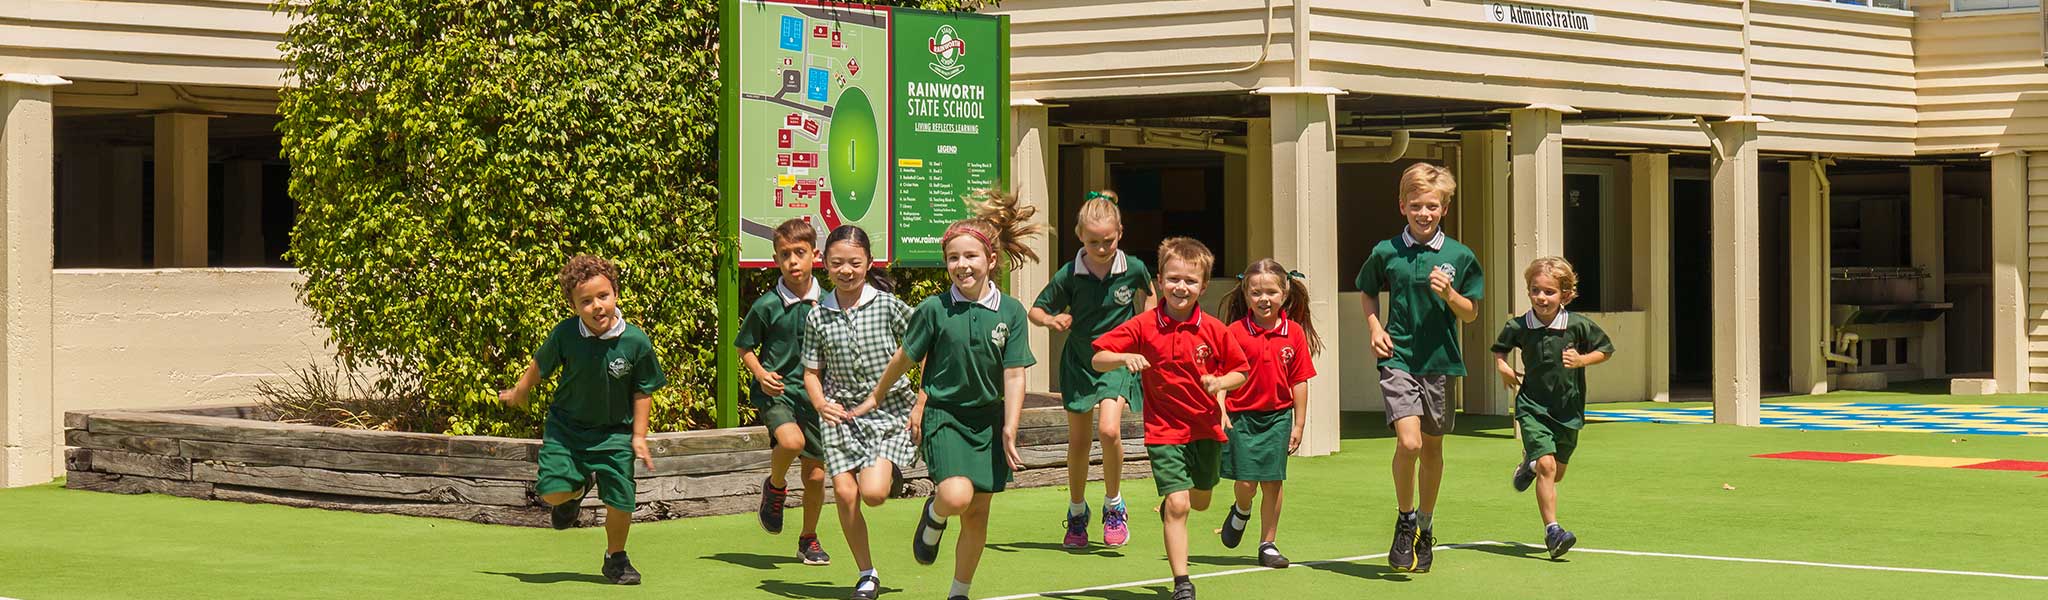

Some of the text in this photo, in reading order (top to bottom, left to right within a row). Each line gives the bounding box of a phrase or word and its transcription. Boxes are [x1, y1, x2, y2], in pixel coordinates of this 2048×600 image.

[1510, 4, 1589, 30] Administration
[908, 81, 985, 100] RAINWORTH
[908, 98, 985, 119] STATE SCHOOL
[915, 122, 979, 134] LIVING REFLECTS LEARNING
[937, 145, 957, 154] LEGEND
